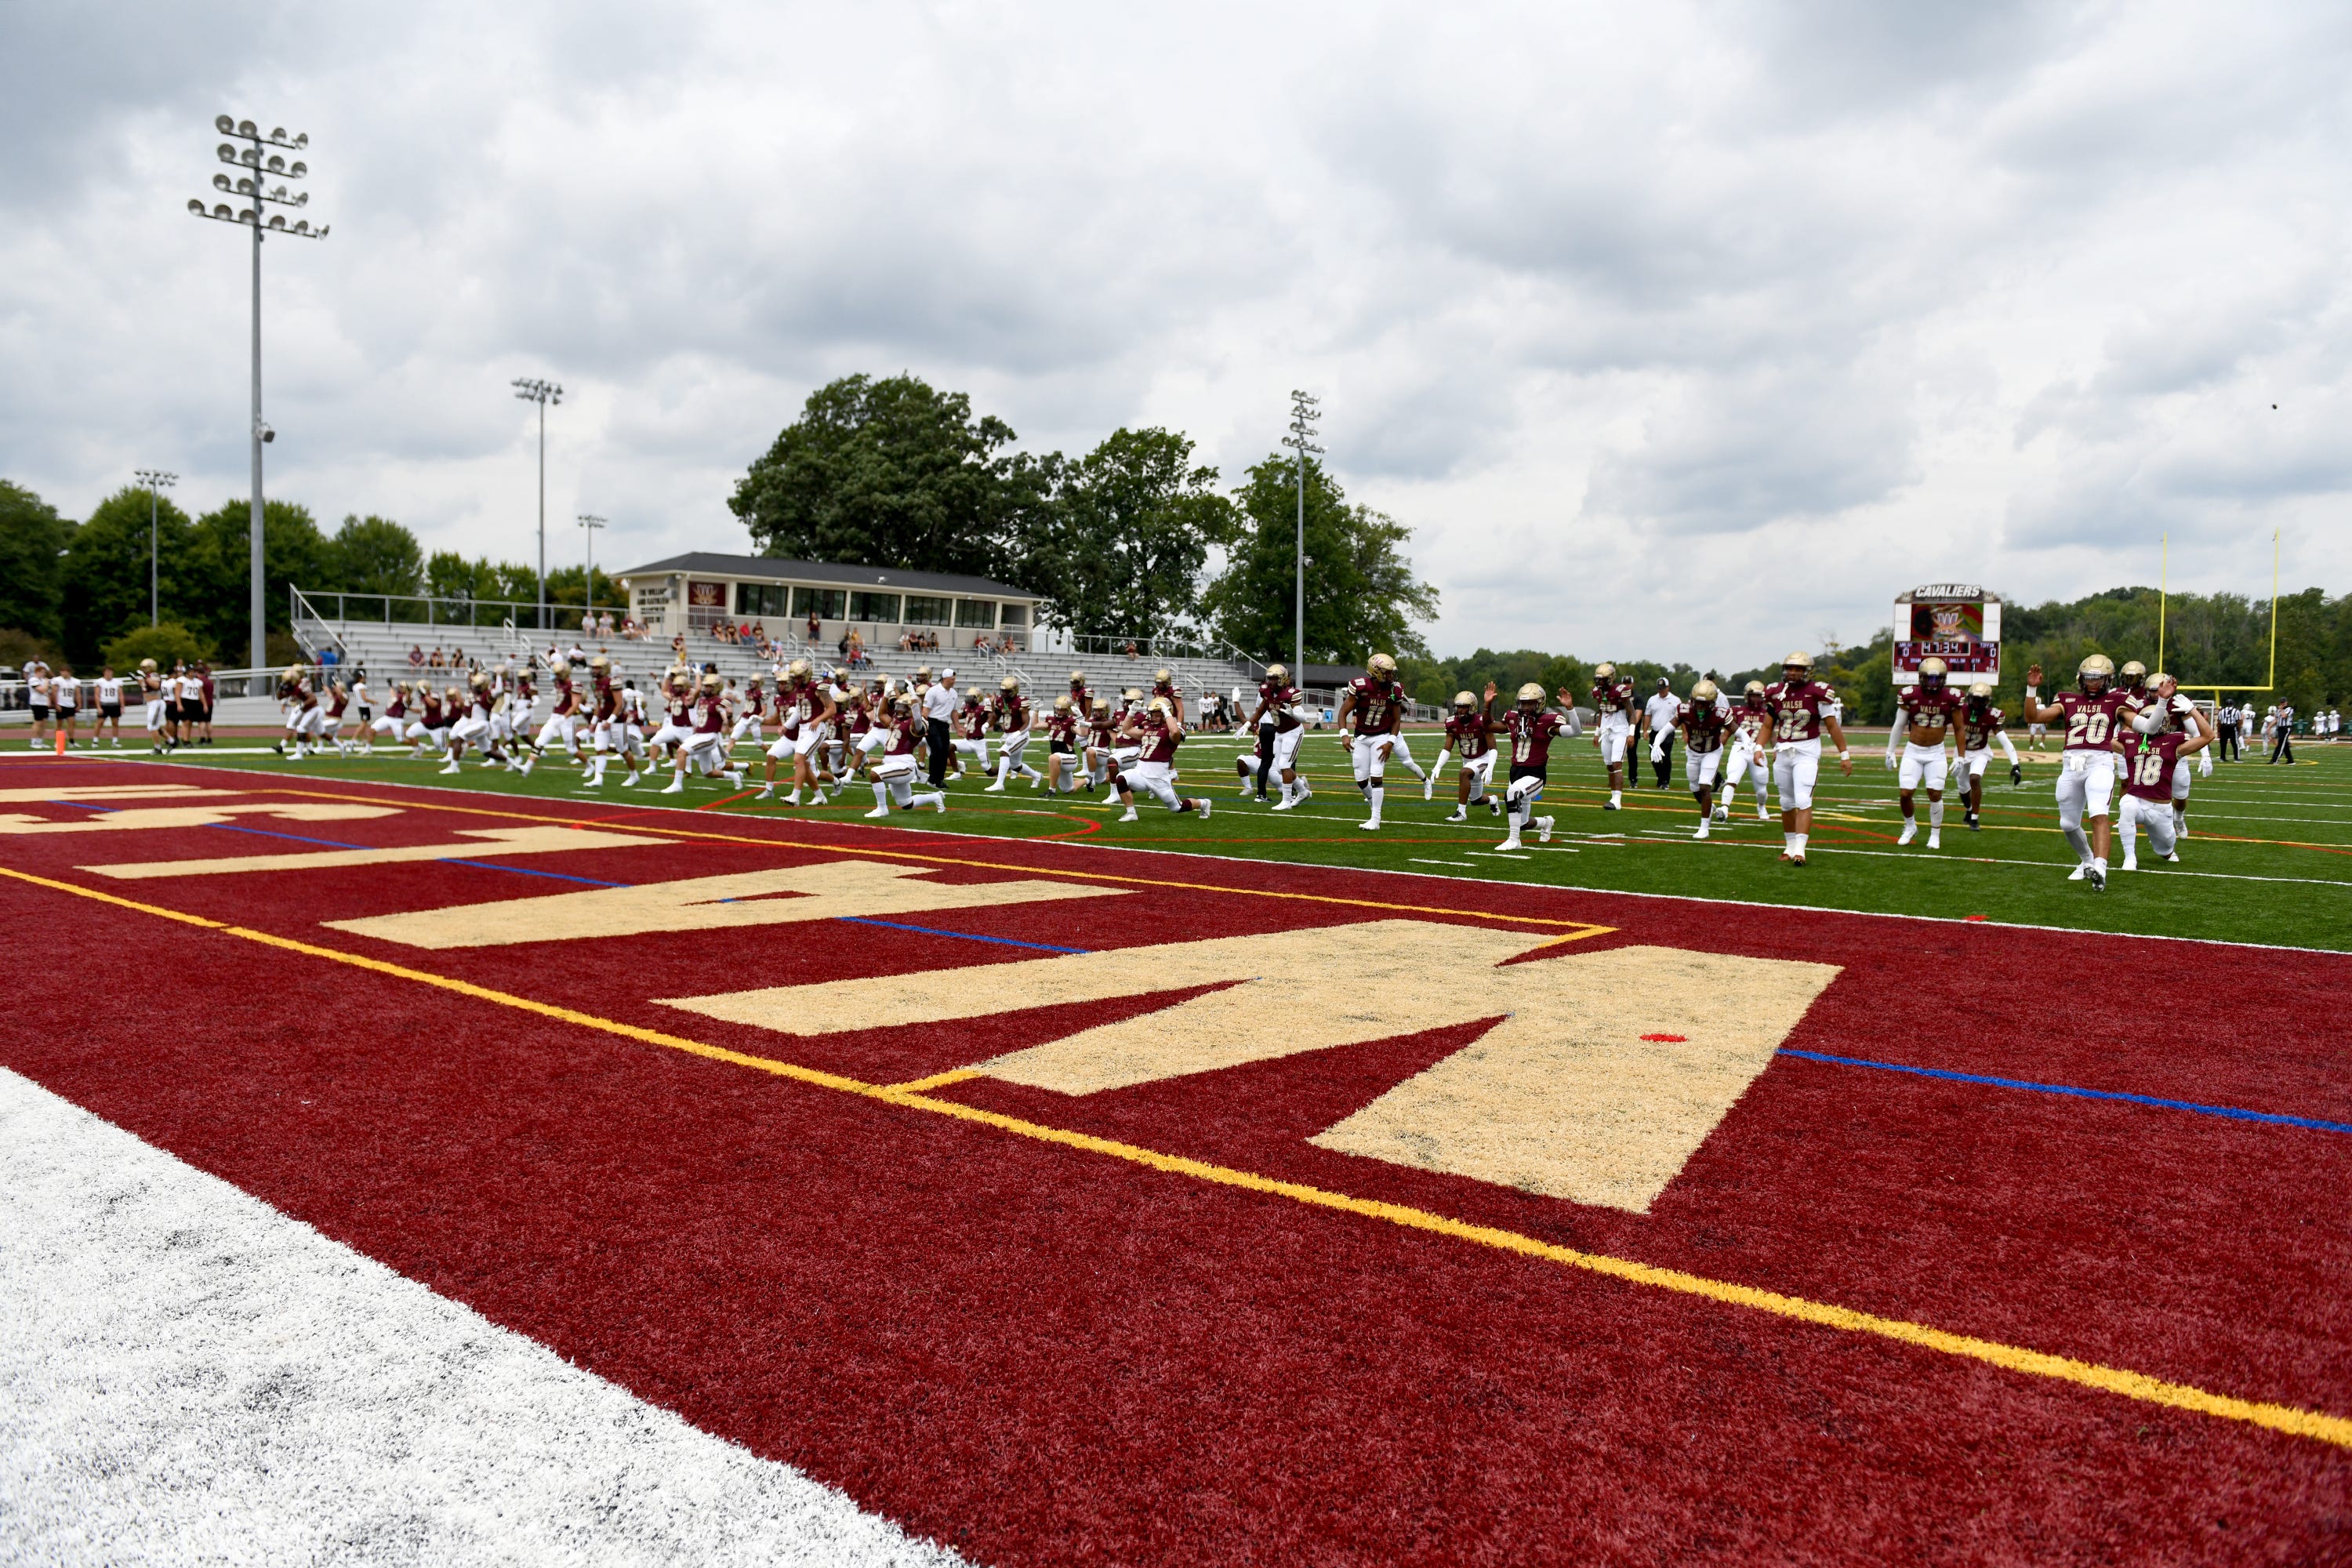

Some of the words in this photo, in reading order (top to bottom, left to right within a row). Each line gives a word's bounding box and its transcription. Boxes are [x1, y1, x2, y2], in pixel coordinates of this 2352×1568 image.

[1915, 586, 1980, 597] CAVALIERS
[1903, 648, 1910, 657] 0
[1989, 648, 1996, 657] 0
[1783, 700, 1803, 709] WALSH
[1920, 706, 1940, 714] WALSH
[2077, 705, 2102, 713] WALSH
[1364, 706, 1386, 726] 11
[1778, 709, 1811, 739] 32
[2067, 712, 2110, 746] 20
[1690, 735, 1713, 753] 21
[2133, 755, 2164, 786] 18
